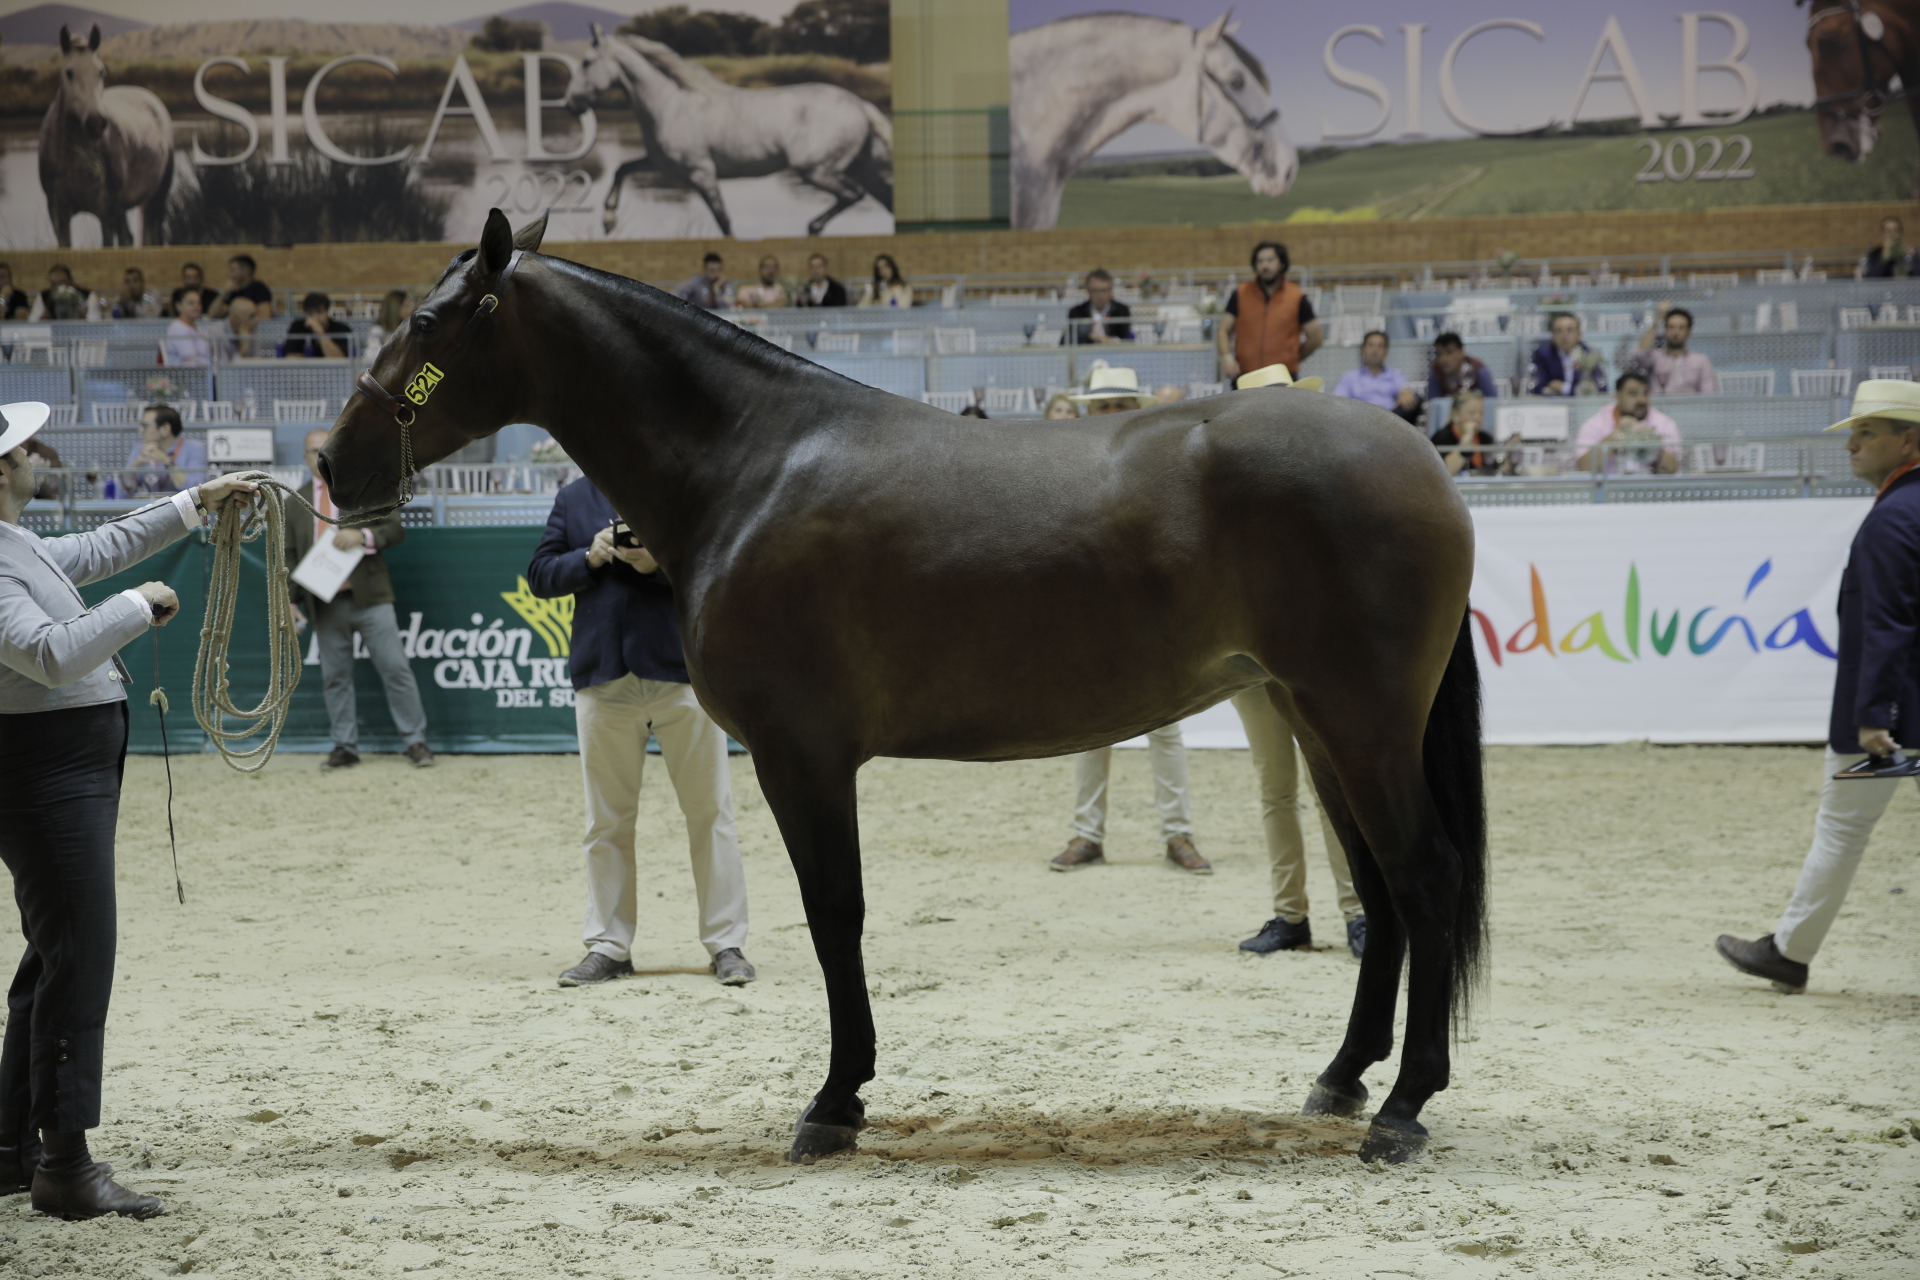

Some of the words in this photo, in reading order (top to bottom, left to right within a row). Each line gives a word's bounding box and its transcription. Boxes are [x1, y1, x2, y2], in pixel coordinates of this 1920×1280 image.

[1321, 12, 1761, 140] SICAB
[192, 52, 598, 166] SICAB
[1635, 136, 1756, 183] 2022
[485, 170, 594, 214] 2022
[406, 364, 443, 403] 521
[1470, 557, 1839, 667] ndalucía
[434, 658, 523, 690] CAJA
[528, 657, 573, 688] RU
[495, 688, 543, 708] DEL
[549, 687, 577, 708] SU
